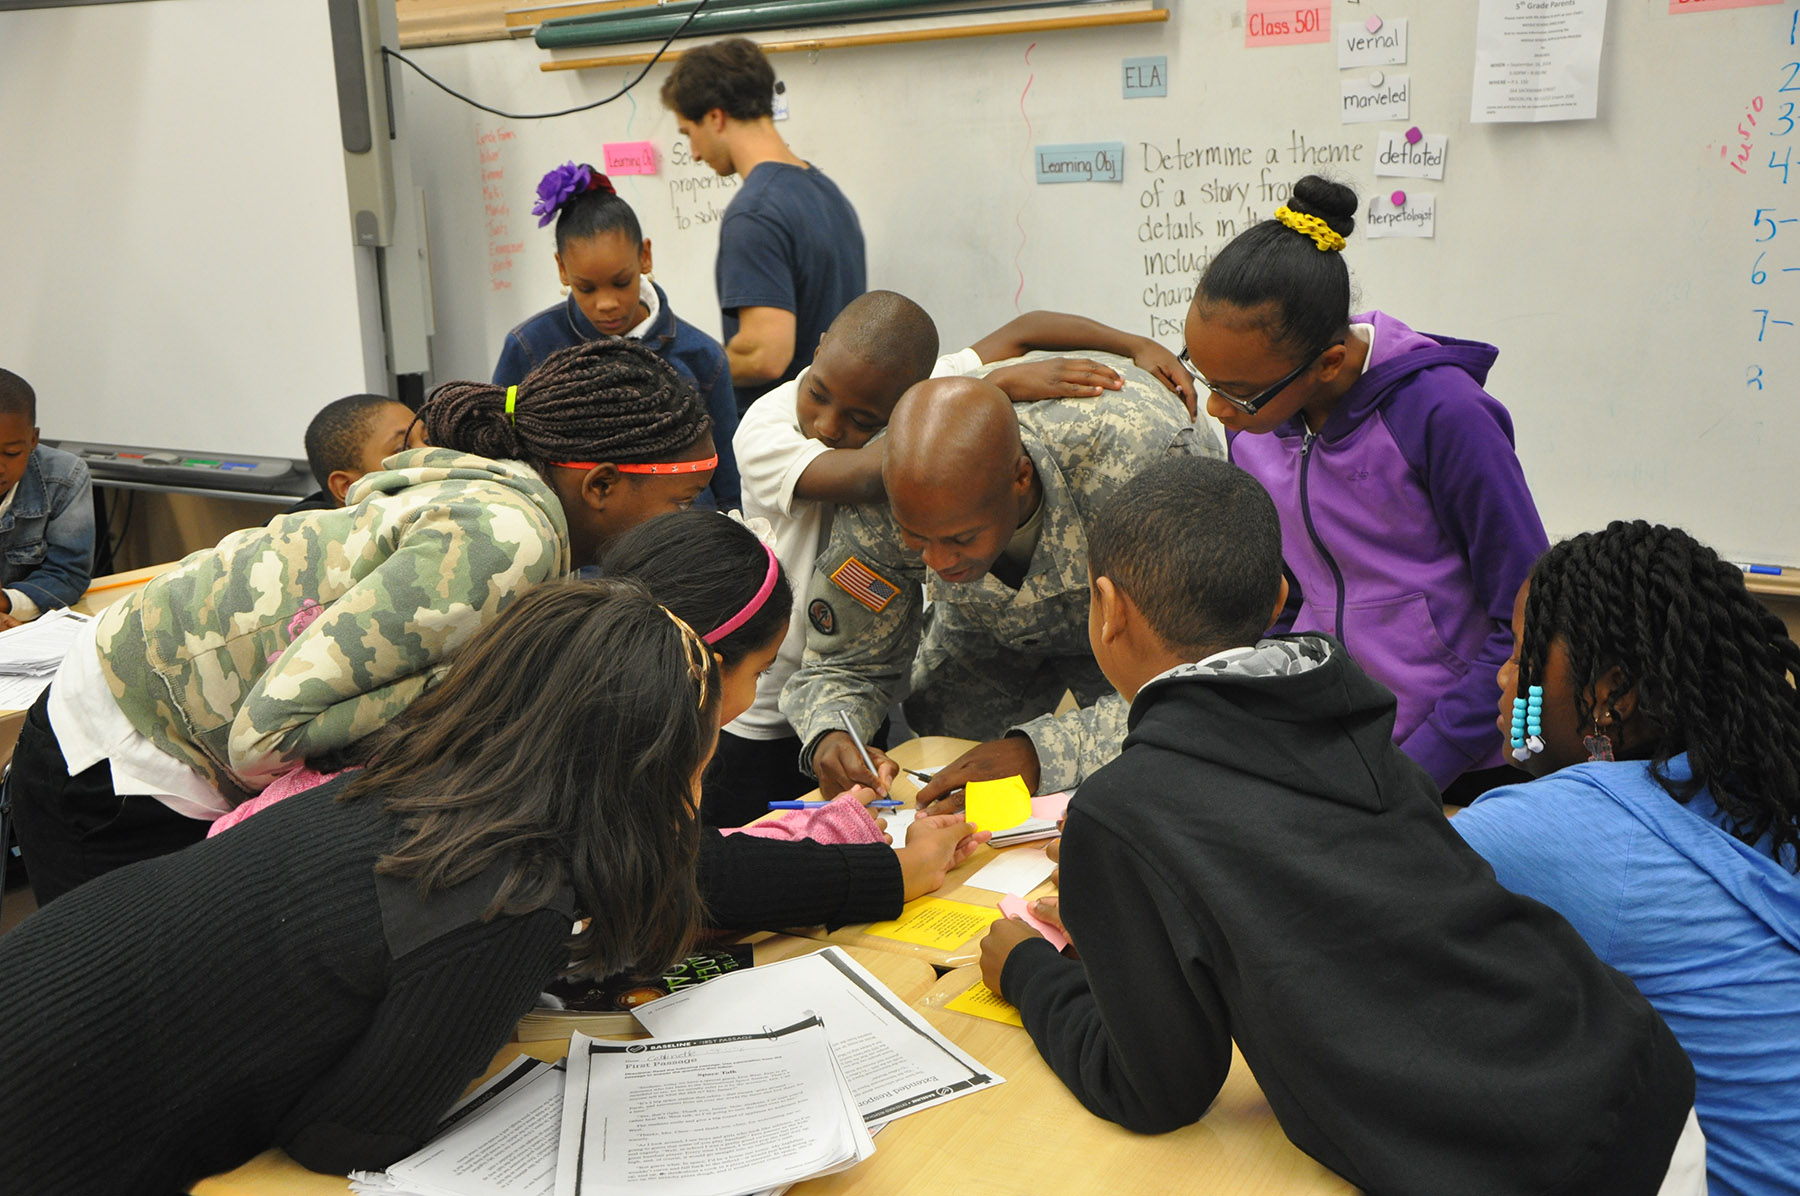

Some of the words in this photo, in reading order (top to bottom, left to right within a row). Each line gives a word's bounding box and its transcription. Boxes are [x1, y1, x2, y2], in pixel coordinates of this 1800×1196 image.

[1527, 2, 1548, 10] Grade
[1249, 12, 1290, 37] Class
[1294, 8, 1320, 34] 501
[1790, 9, 1799, 45] 1
[1347, 28, 1399, 52] vernal
[1778, 62, 1800, 93] 2
[1343, 84, 1407, 110] marveled
[1139, 138, 1252, 173] Determine
[1265, 148, 1280, 165] a
[1287, 129, 1363, 165] theme
[1379, 139, 1442, 167] deflated
[1040, 152, 1093, 181] Learning
[1095, 150, 1116, 180] Obj
[1140, 177, 1165, 209] of
[1174, 189, 1187, 207] a
[1200, 178, 1250, 214] story
[675, 206, 691, 230] to
[1138, 212, 1204, 243] details
[1216, 212, 1236, 237] in
[1368, 206, 1432, 228] herpetologist
[650, 1041, 692, 1051] BASELINE
[625, 1062, 651, 1070] First
[653, 1058, 698, 1067] Passage
[892, 1075, 940, 1095] Extended
